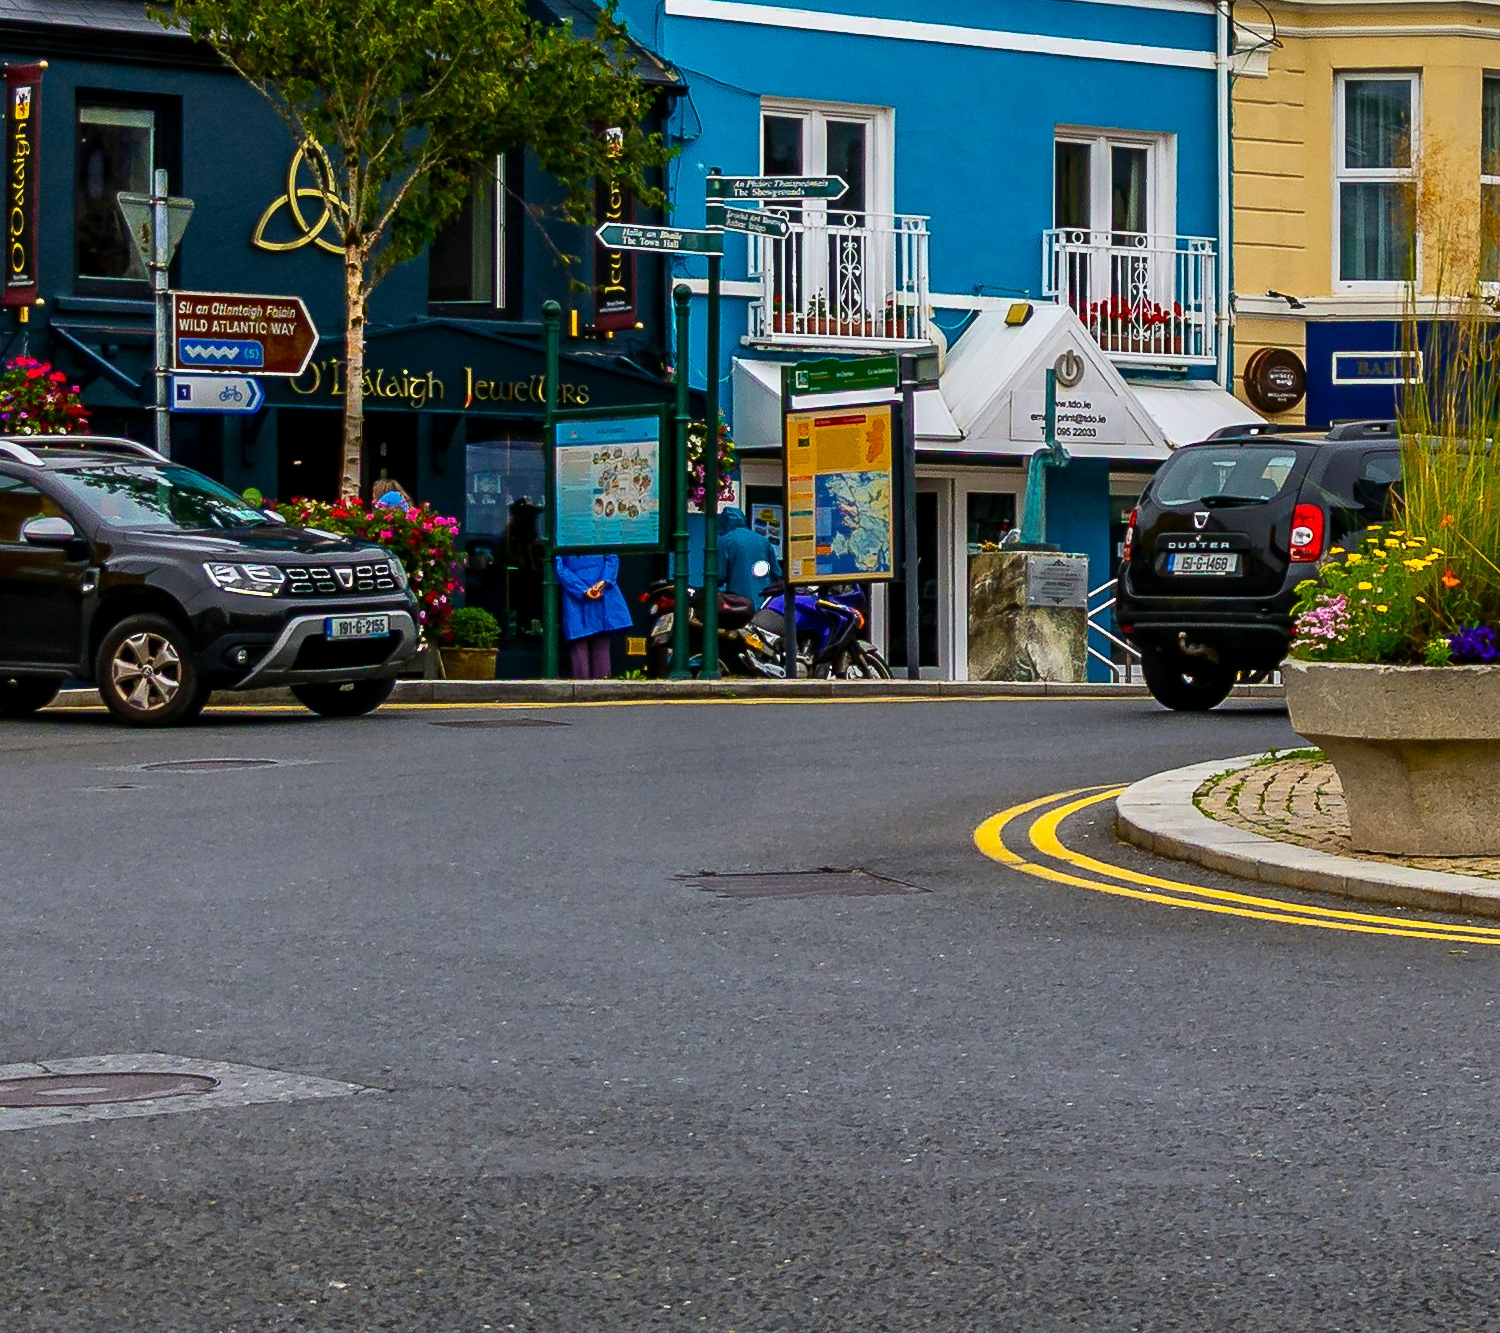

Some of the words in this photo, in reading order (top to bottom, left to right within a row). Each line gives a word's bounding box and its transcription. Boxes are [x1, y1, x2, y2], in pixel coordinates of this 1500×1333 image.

[733, 188, 748, 197] The
[752, 188, 805, 198] Showgrounds
[622, 236, 636, 245] The
[640, 237, 660, 247] Town
[663, 240, 679, 248] Hall
[196, 305, 208, 314] an
[179, 318, 208, 332] WILD
[212, 320, 268, 334] ATLANTIC
[270, 322, 298, 336] WAY
[1056, 427, 1072, 437] 095
[1073, 427, 1097, 438] 22033
[1181, 556, 1229, 571] 151-G-1468
